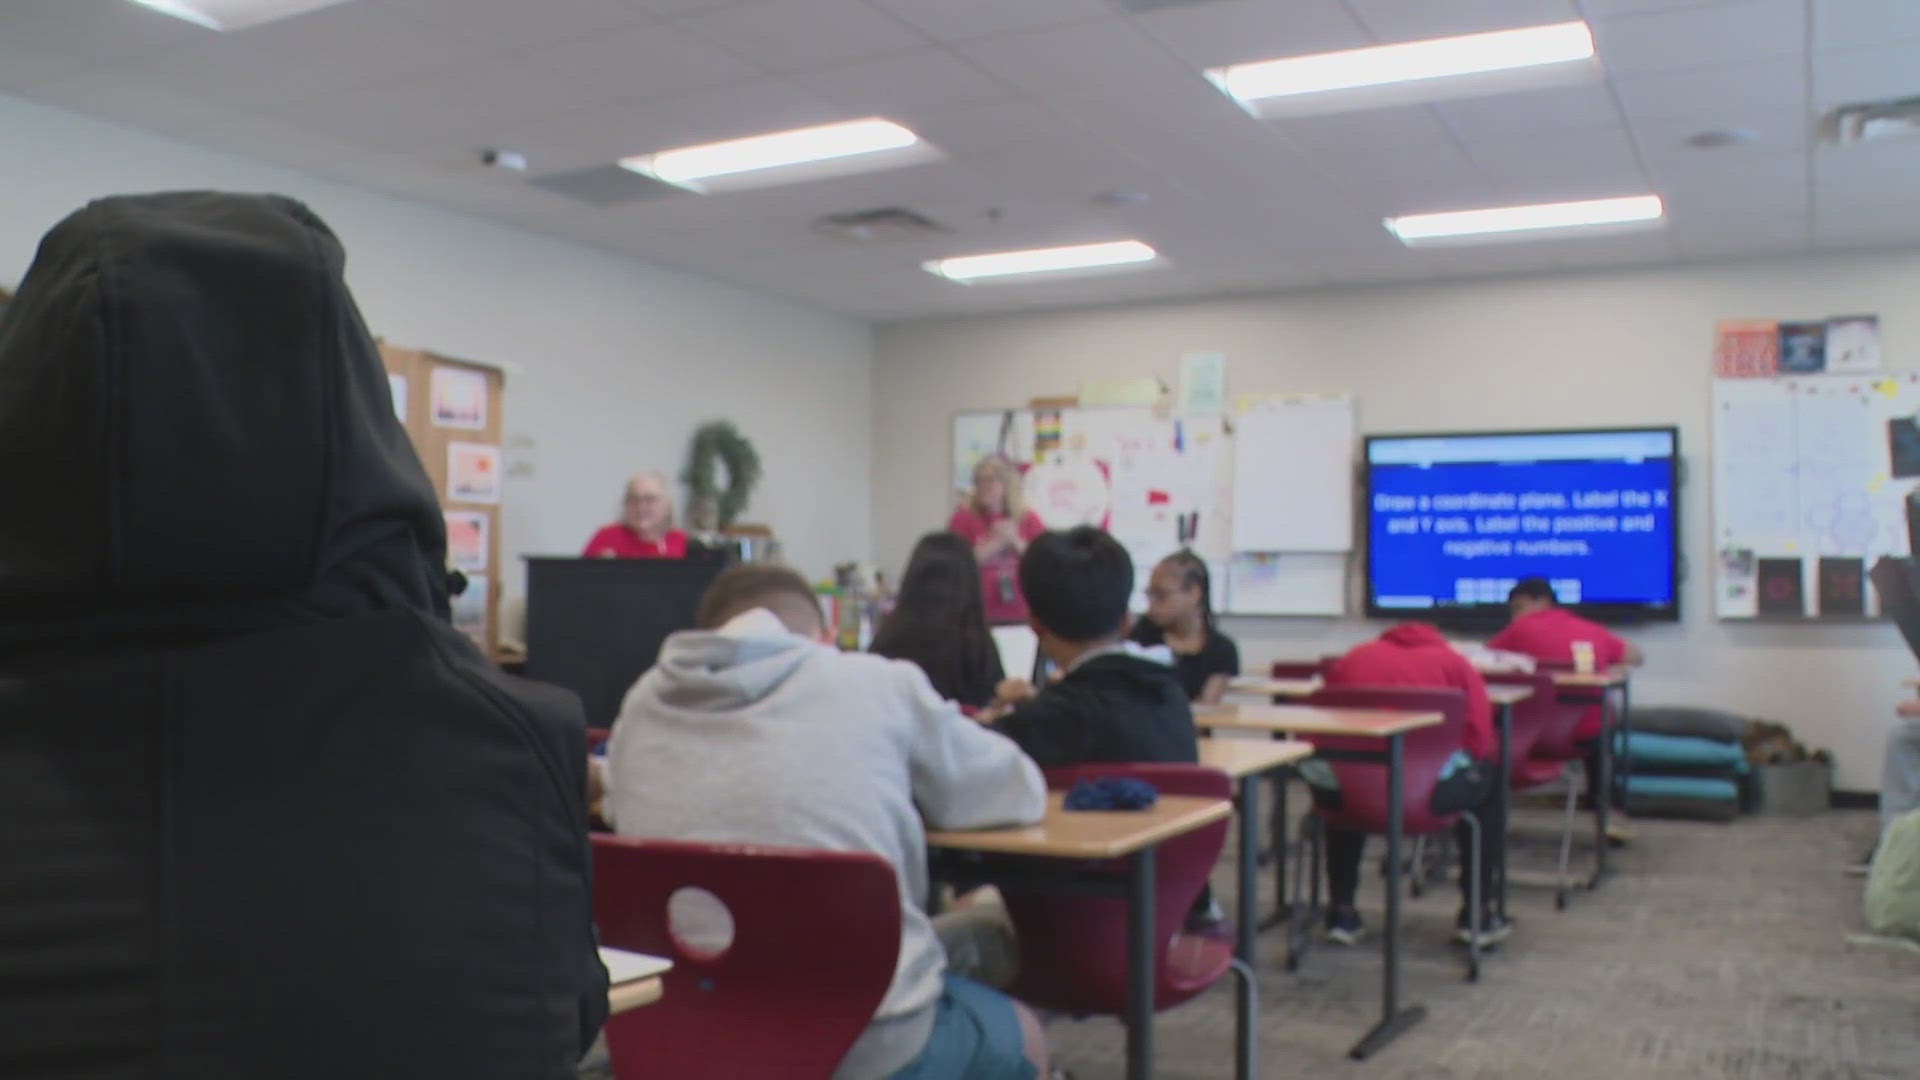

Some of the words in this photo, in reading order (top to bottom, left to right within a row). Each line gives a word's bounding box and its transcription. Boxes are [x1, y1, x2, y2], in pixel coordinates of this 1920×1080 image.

[1374, 493, 1415, 511] Draw
[1419, 495, 1430, 511] a
[1433, 492, 1515, 510] coordinate
[1572, 490, 1619, 509] Label
[1621, 490, 1650, 508] the
[1654, 490, 1668, 507] X
[1387, 516, 1419, 533] and
[1420, 516, 1432, 533] Y
[1475, 515, 1519, 533] Label
[1521, 514, 1549, 533] the
[1552, 514, 1617, 534] positive
[1620, 512, 1654, 532] and
[1442, 539, 1512, 559] negative
